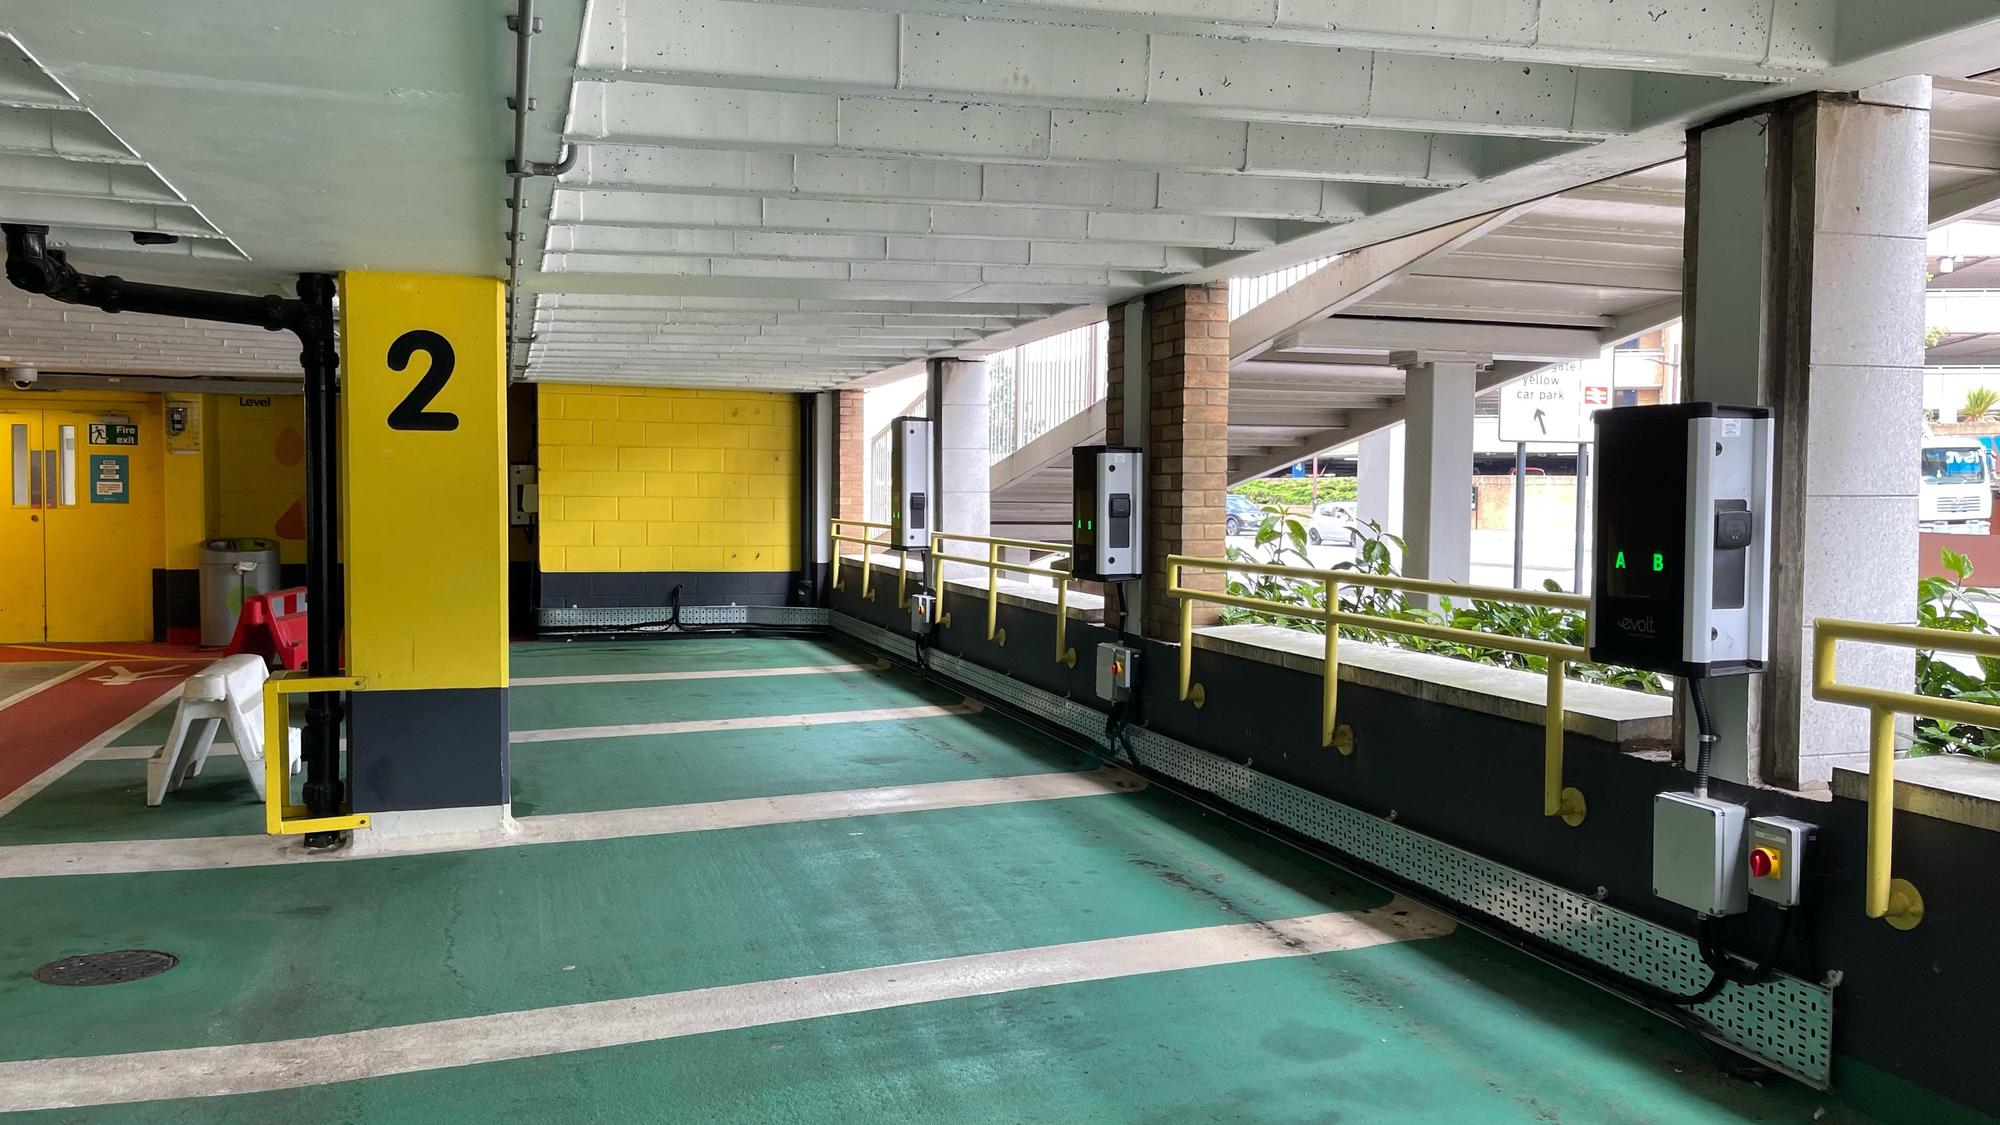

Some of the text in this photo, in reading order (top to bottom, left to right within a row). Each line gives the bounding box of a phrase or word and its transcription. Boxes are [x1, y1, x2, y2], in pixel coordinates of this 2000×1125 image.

[387, 329, 460, 432] 2
[1522, 373, 1560, 387] yellow
[1516, 388, 1565, 401] car park
[239, 396, 271, 407] Level
[116, 425, 136, 435] Fire
[116, 436, 135, 444] exit
[1295, 462, 1303, 472] 4
[1077, 519, 1082, 529] A
[1615, 551, 1664, 571] A B
[1617, 615, 1656, 634] evolt
